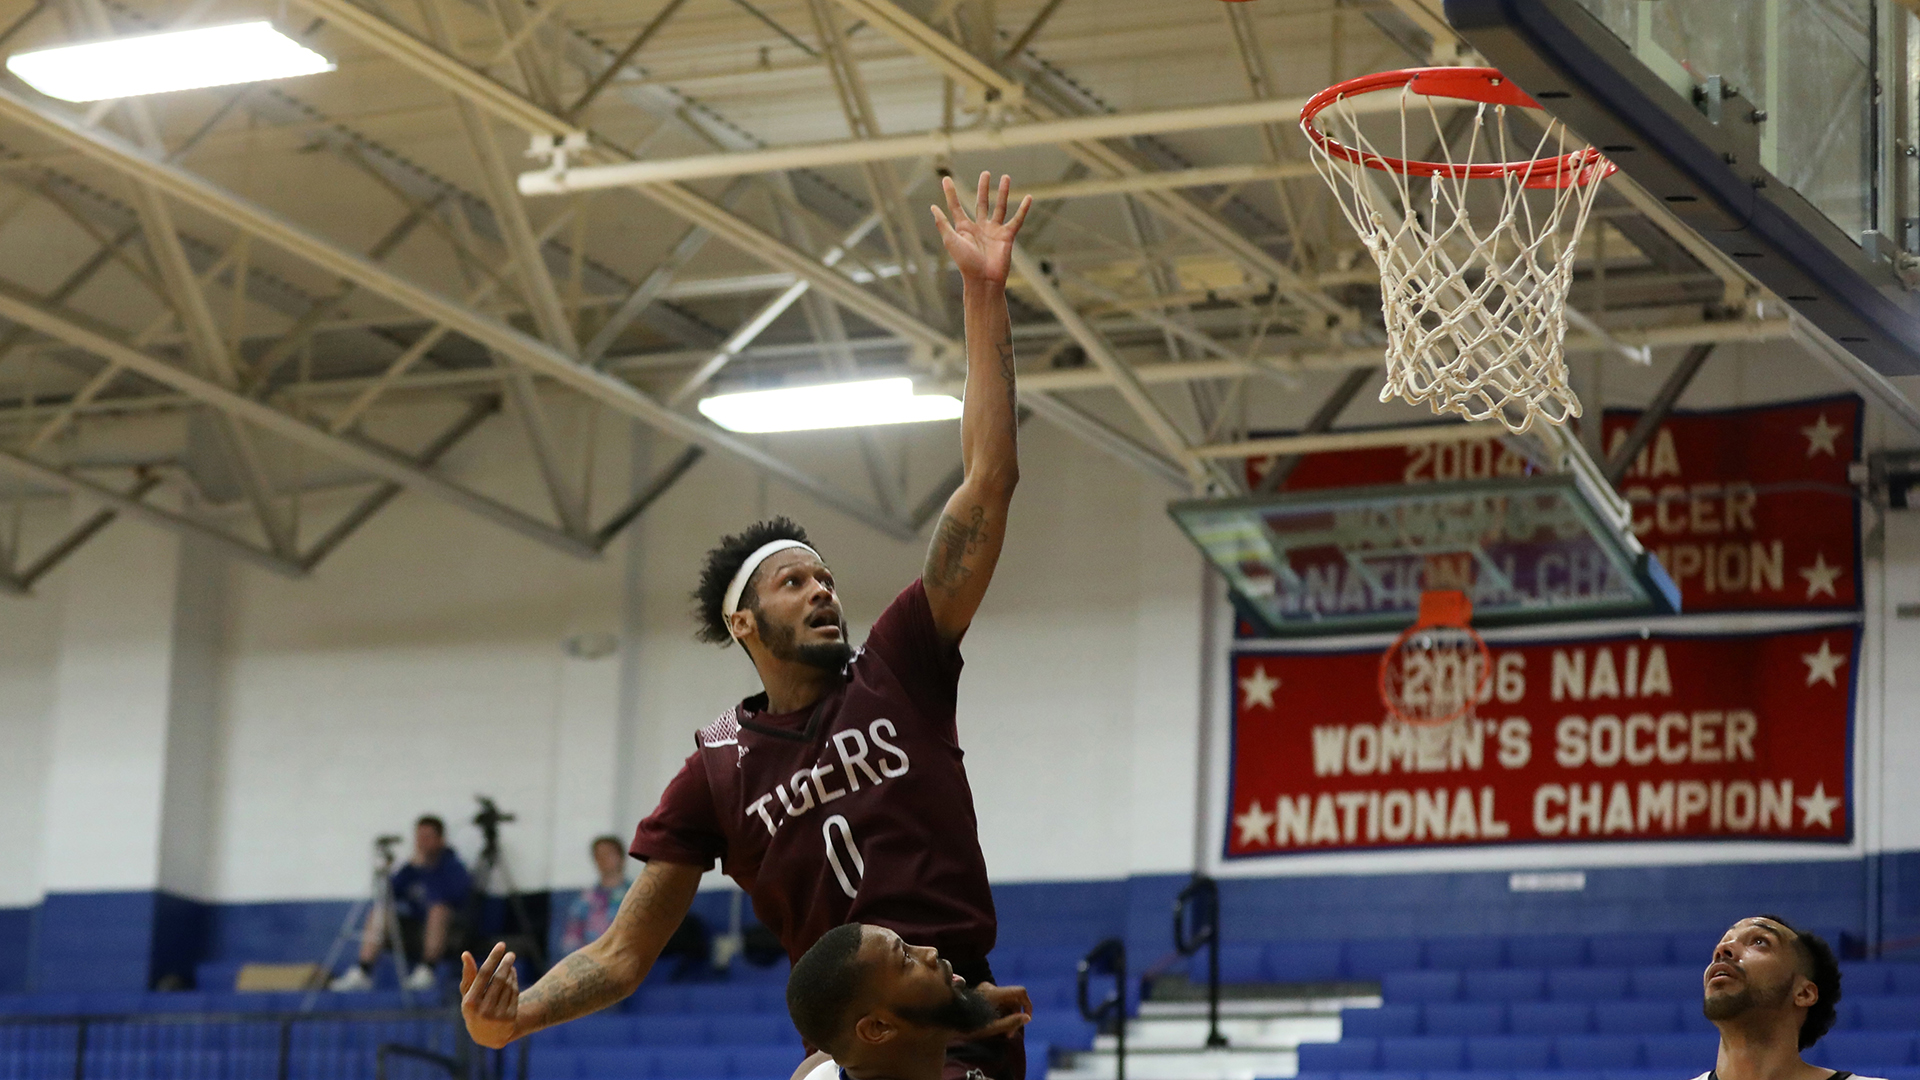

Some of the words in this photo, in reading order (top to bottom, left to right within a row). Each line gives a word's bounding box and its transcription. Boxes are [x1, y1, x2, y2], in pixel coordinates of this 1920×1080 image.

[1404, 440, 1524, 483] 2004
[1606, 426, 1681, 478] AIA
[1402, 651, 1527, 705] 2006
[1551, 644, 1673, 702] NAIA
[1311, 715, 1532, 777] WOMEN'S
[1554, 709, 1758, 769] SOCCER
[745, 717, 910, 838] TIGERS
[1274, 784, 1510, 846] NATIONAL
[1532, 778, 1794, 836] CHAMPION
[822, 813, 865, 900] 0
